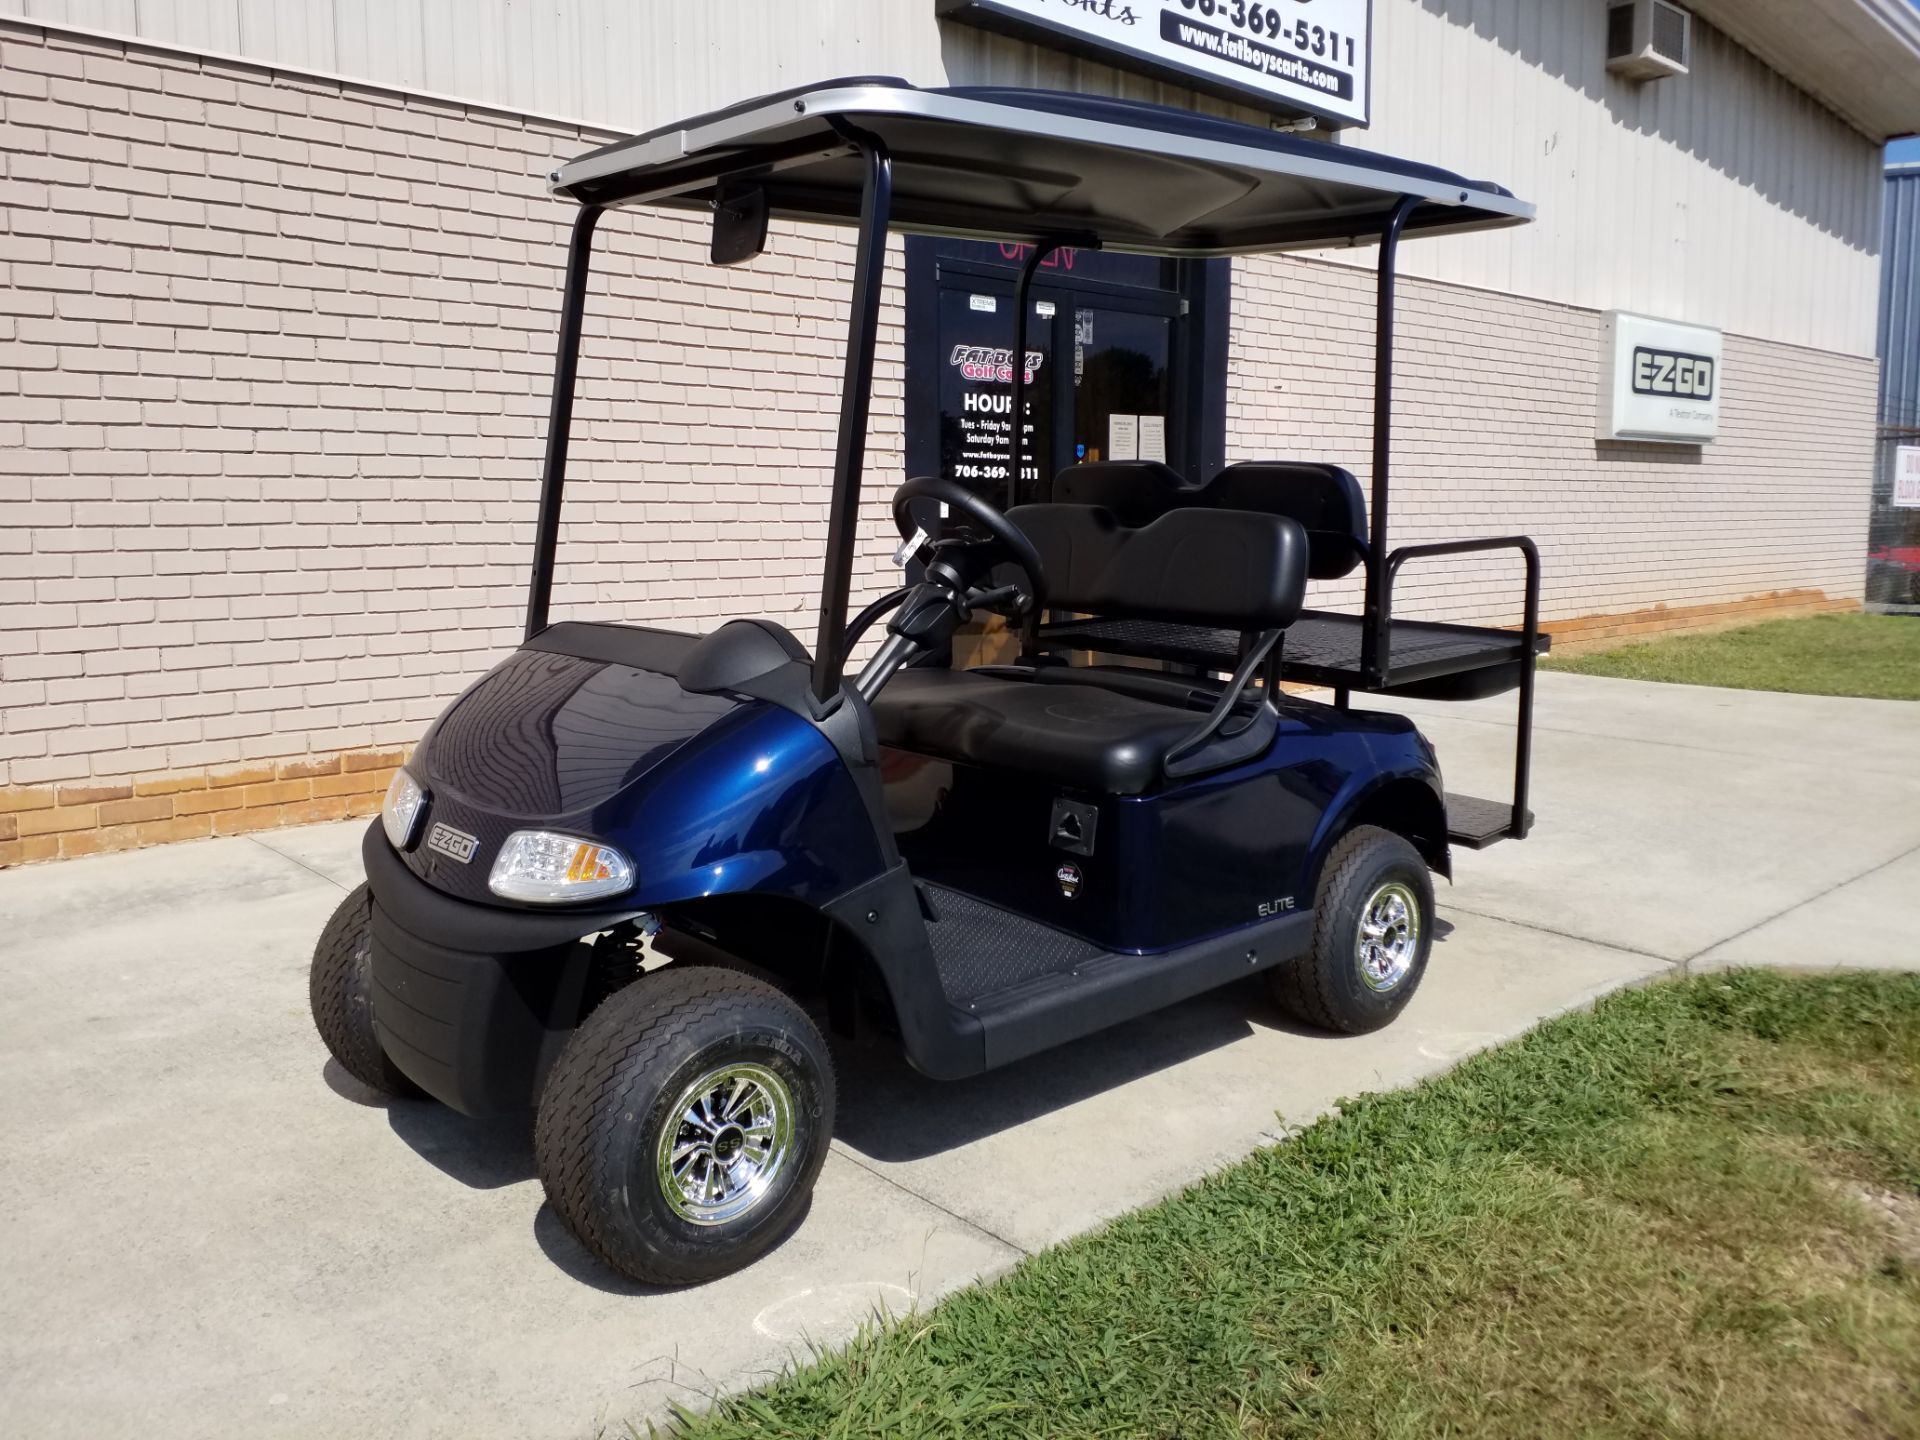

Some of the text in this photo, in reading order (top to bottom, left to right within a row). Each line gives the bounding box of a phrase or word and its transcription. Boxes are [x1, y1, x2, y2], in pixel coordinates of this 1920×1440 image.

[1166, 0, 1355, 67] 6-369-5311
[1179, 24, 1339, 91] www.fatboyscarts.com
[999, 243, 1074, 269] OPN
[963, 364, 1032, 382] Golf Cas
[1634, 351, 1712, 397] EZGO
[964, 393, 1030, 415] HOU:
[961, 419, 975, 429] Tues
[981, 420, 1000, 433] Friday
[966, 433, 995, 446] Saturday
[955, 464, 1038, 480] 706-369-11
[430, 825, 475, 858] EZGO
[1258, 896, 1295, 917] ELITE
